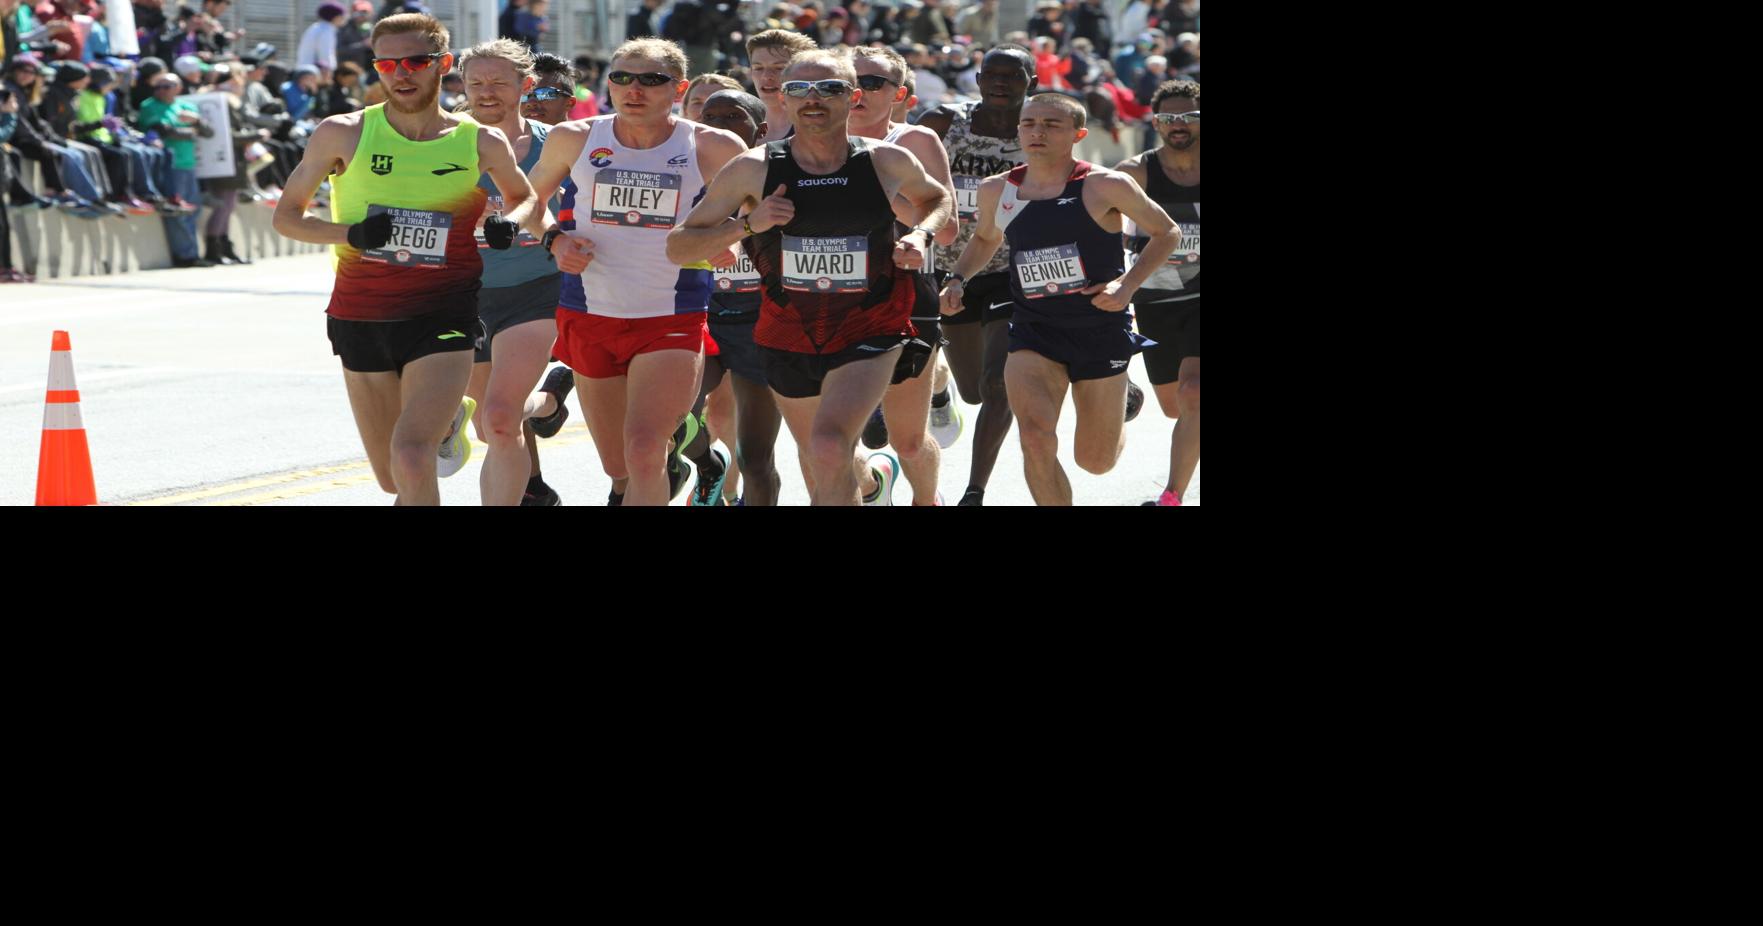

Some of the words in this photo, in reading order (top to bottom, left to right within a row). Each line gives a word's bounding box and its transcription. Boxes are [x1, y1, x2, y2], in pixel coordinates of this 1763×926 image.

[616, 171, 630, 179] U.S.
[631, 172, 661, 181] OLYMPIC
[616, 178, 634, 186] TEAM
[636, 180, 660, 188] TRIALS
[797, 177, 848, 187] saucony
[609, 186, 664, 210] RILEY
[387, 208, 401, 216] U.S.
[402, 210, 433, 220] OLYMPIC
[407, 217, 433, 227] TRIALS
[387, 225, 437, 250] REGG
[801, 238, 816, 246] U.S.
[817, 238, 847, 246] OLYMPIC
[802, 245, 821, 253] TEAM
[823, 245, 847, 253] TRIALS
[1034, 247, 1060, 257] OLYMPIC
[1025, 255, 1041, 264] TEAM
[1041, 253, 1062, 263] TRIALS
[794, 253, 854, 275] WARD
[1021, 259, 1077, 283] BENNIE
